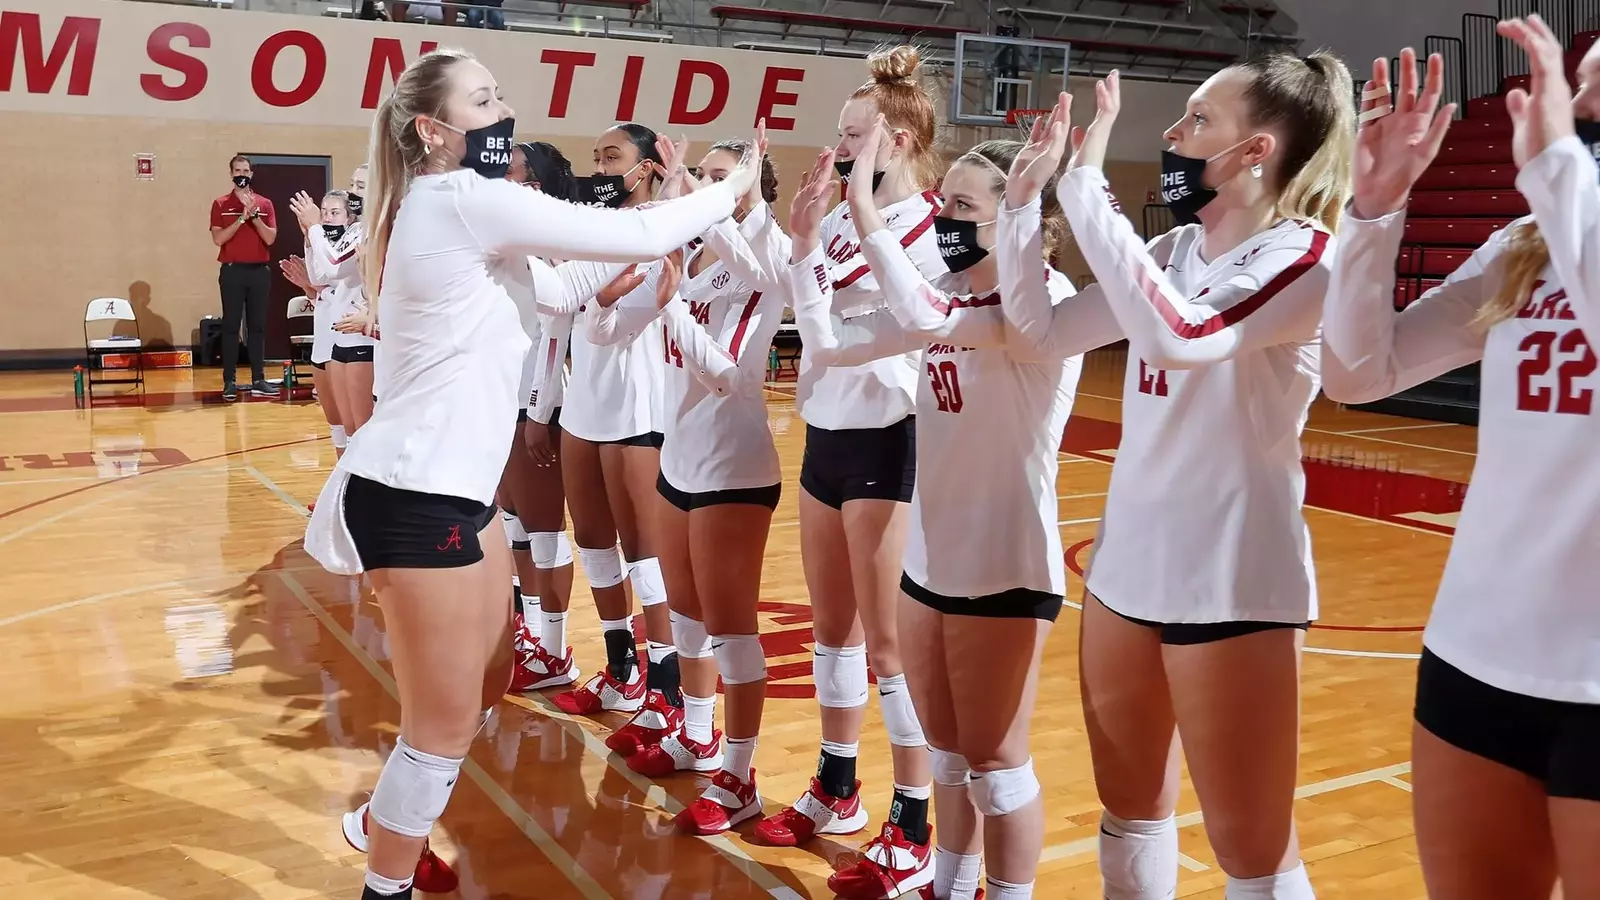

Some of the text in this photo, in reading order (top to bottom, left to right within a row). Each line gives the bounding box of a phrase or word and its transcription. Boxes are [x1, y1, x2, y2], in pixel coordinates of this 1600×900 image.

[540, 49, 805, 131] TIDE
[486, 136, 505, 149] BE
[480, 151, 512, 165] CHA
[594, 183, 614, 194] THE
[1161, 171, 1185, 187] THE
[1161, 185, 1193, 204] NGE
[936, 232, 960, 244] THE
[940, 245, 970, 258] NGE
[813, 263, 830, 295] ROLL
[1516, 328, 1598, 416] 22
[926, 360, 964, 414] 20
[529, 389, 539, 408] TIDE
[436, 523, 464, 552] A
